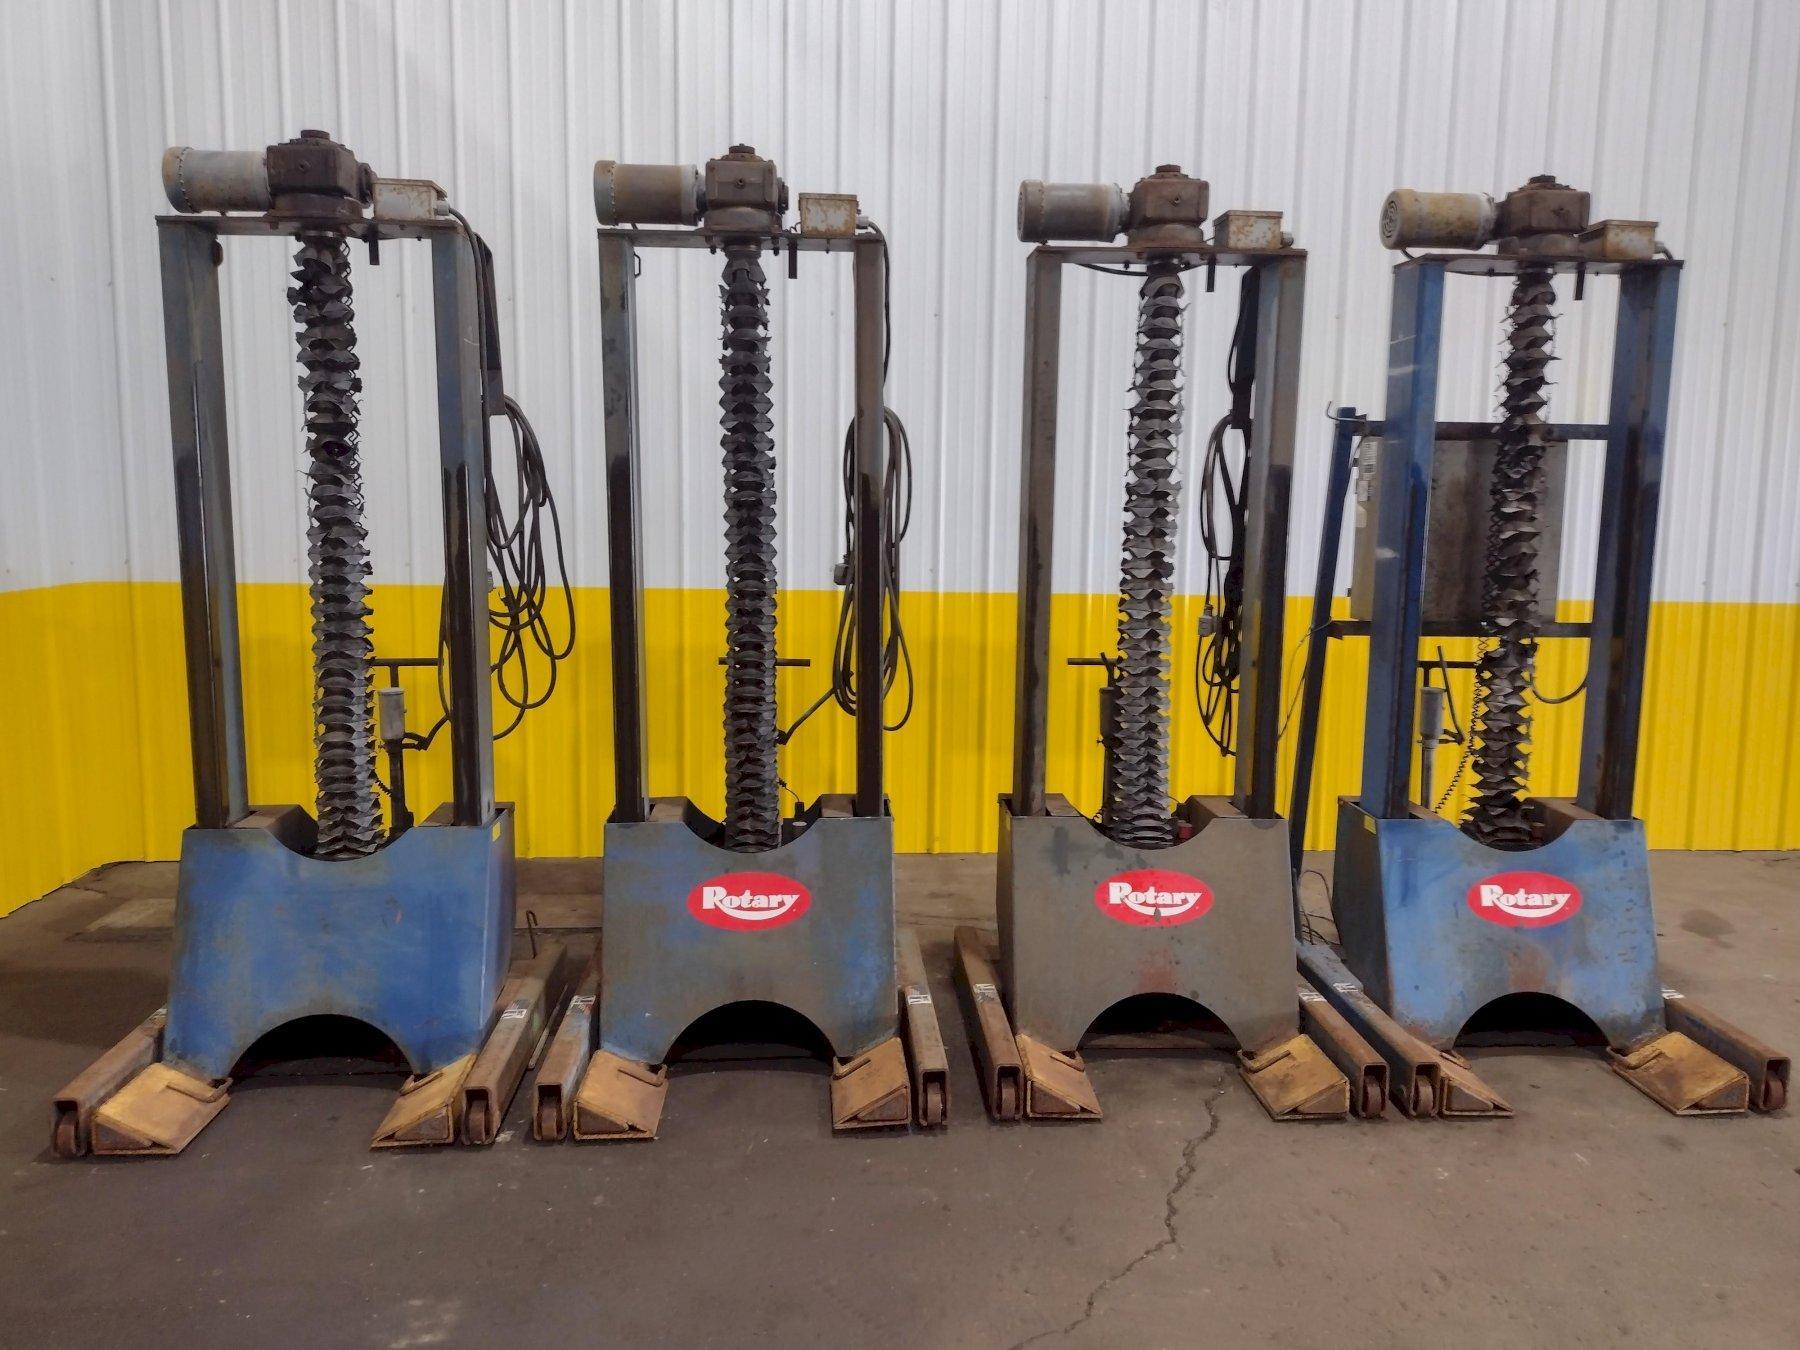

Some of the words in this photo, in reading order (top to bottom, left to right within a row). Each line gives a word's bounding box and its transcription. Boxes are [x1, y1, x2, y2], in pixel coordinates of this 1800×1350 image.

[702, 886, 800, 920] Rotary
[1108, 882, 1202, 916] Rotary
[1480, 884, 1571, 917] Rotary
